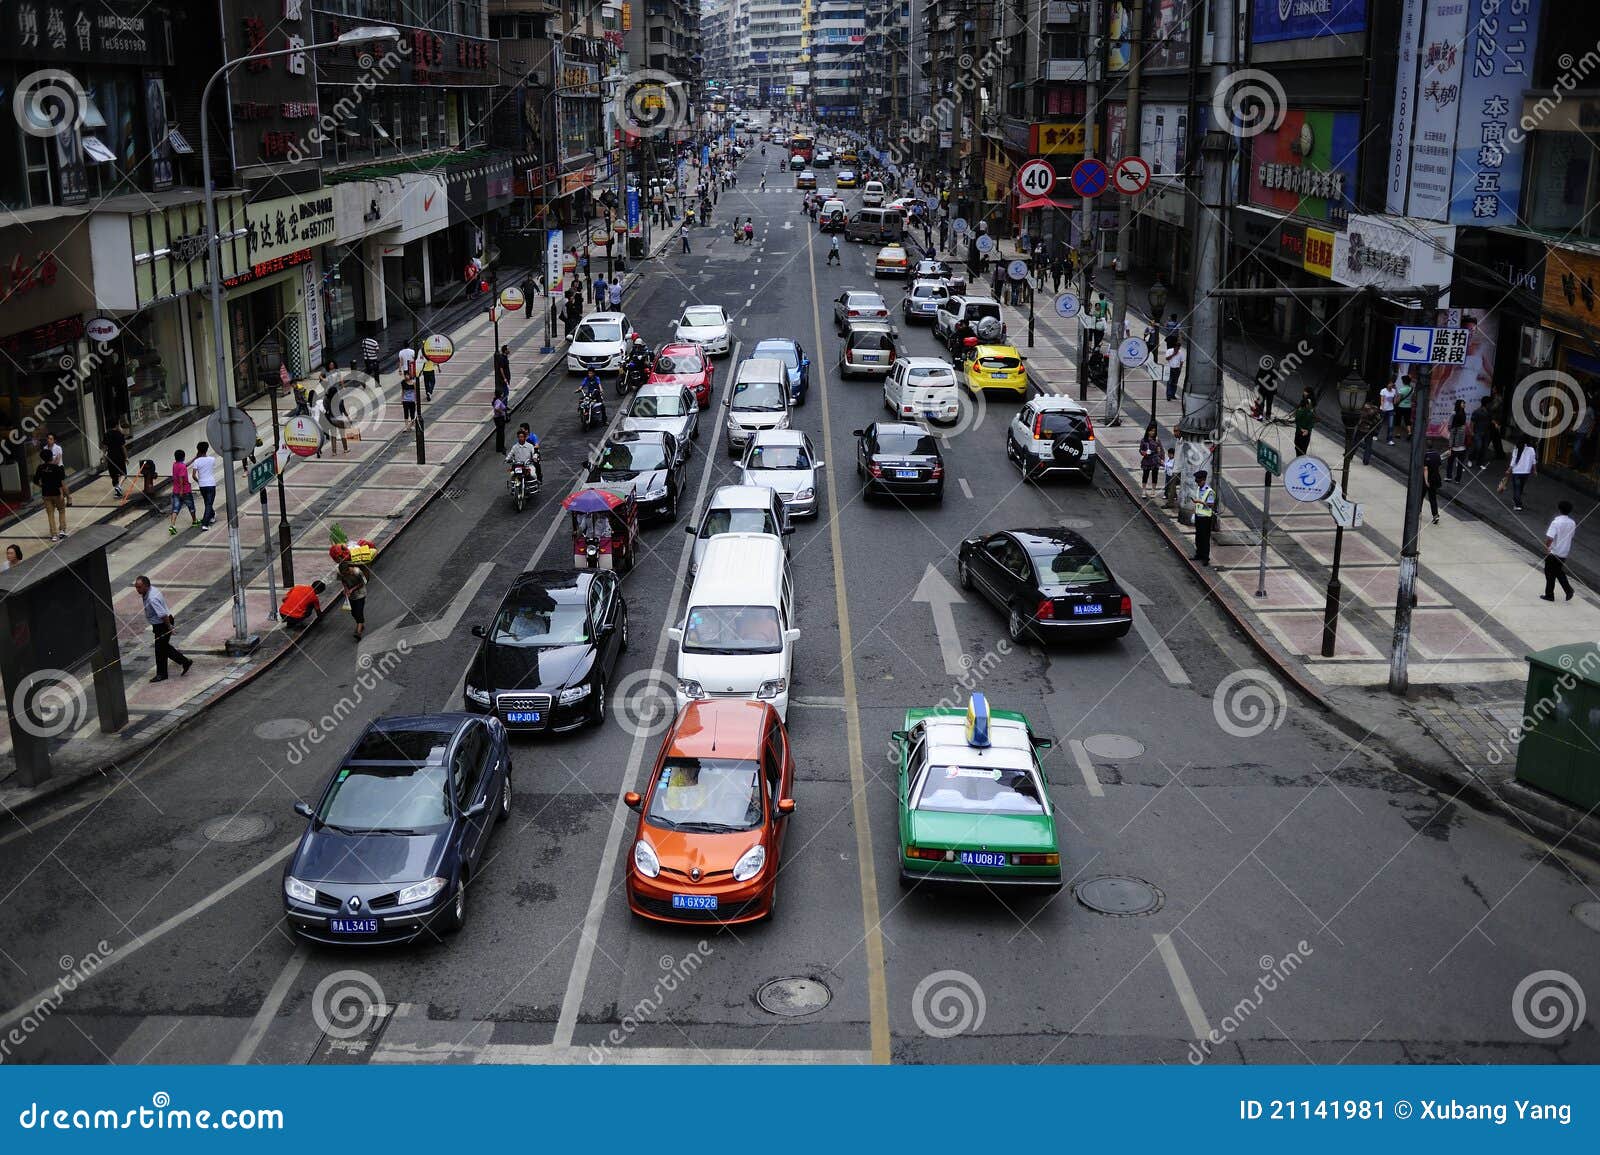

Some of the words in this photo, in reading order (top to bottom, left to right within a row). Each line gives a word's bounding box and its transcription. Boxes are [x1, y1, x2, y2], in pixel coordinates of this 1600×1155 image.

[97, 15, 118, 29] HAIR
[118, 17, 145, 31] DESIGN
[1473, 96, 1509, 218] 本商场五楼
[1025, 169, 1049, 189] 40
[1509, 265, 1537, 290] Love
[1434, 329, 1467, 347] 监拍
[1431, 346, 1465, 363] 路段
[1058, 441, 1080, 458] Jeep
